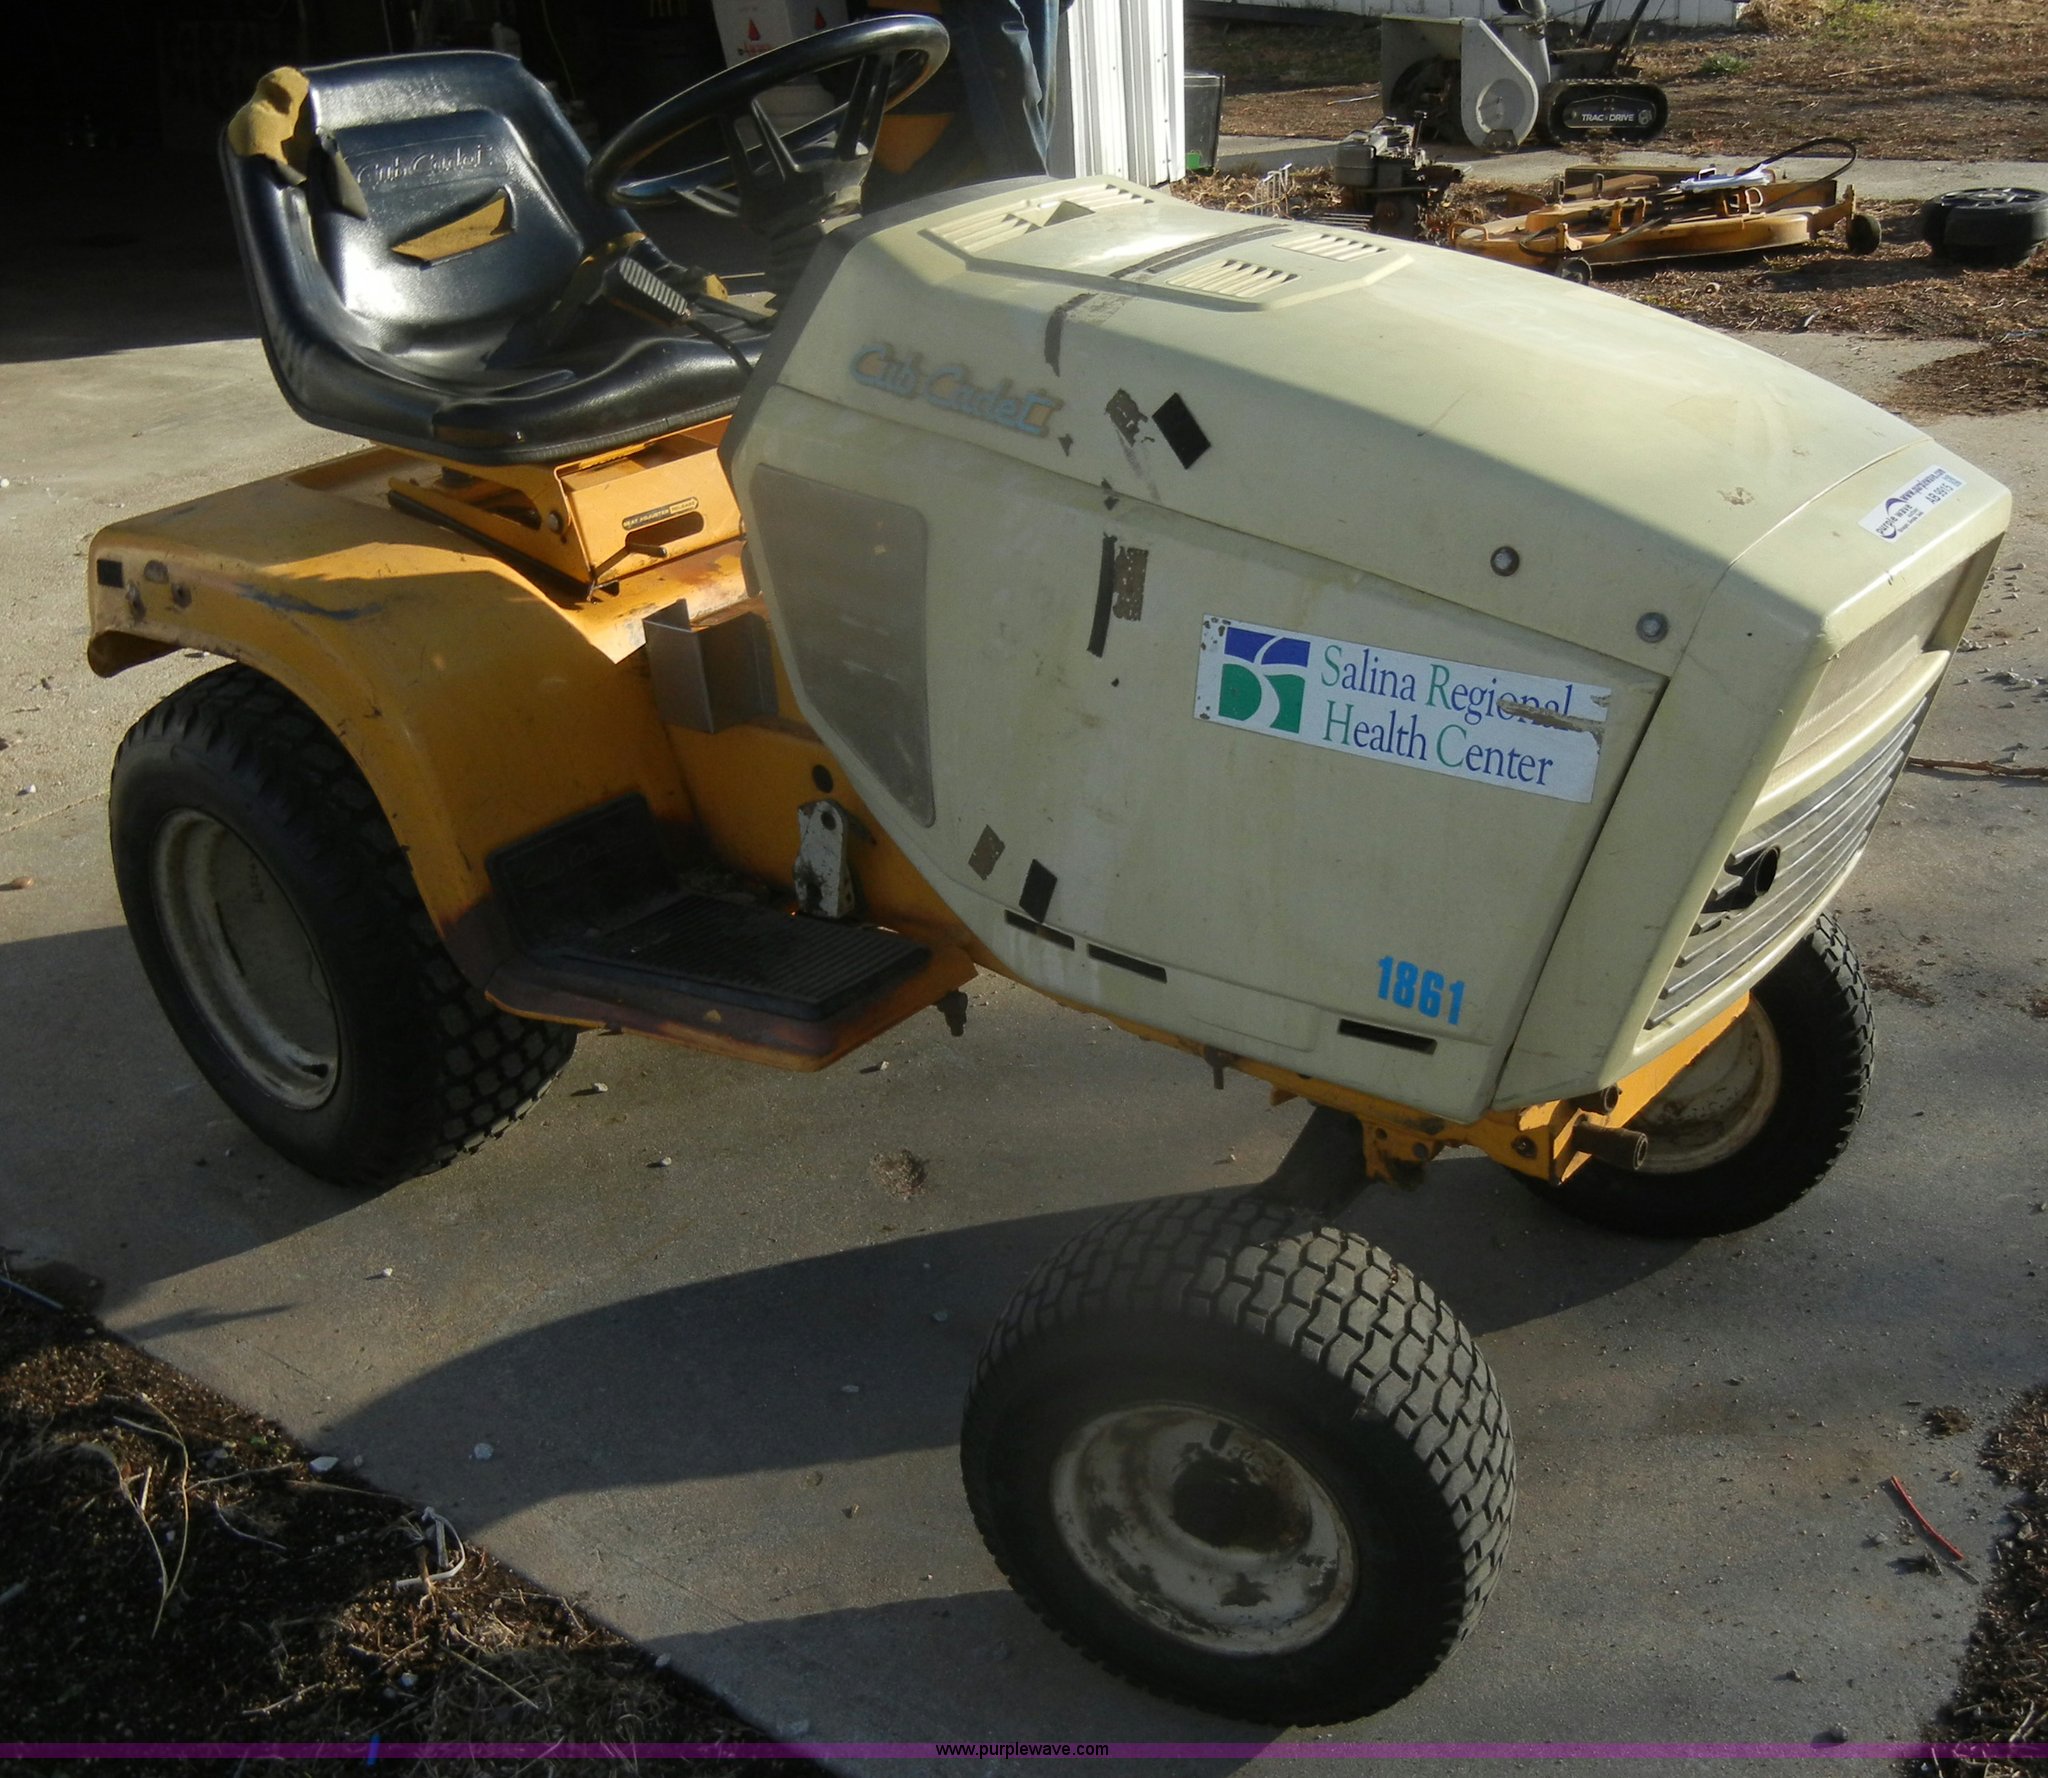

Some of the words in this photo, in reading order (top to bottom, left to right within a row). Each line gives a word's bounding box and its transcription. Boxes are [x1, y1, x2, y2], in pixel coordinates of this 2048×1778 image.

[1582, 113, 1604, 122] TRAC
[1609, 113, 1635, 122] DRIVE
[850, 341, 925, 399] Cub
[924, 362, 1066, 438] Cadet
[1321, 645, 1416, 702] Salina
[1323, 700, 1428, 761] Health
[1436, 724, 1554, 786] Center
[1377, 955, 1465, 1025] 1861
